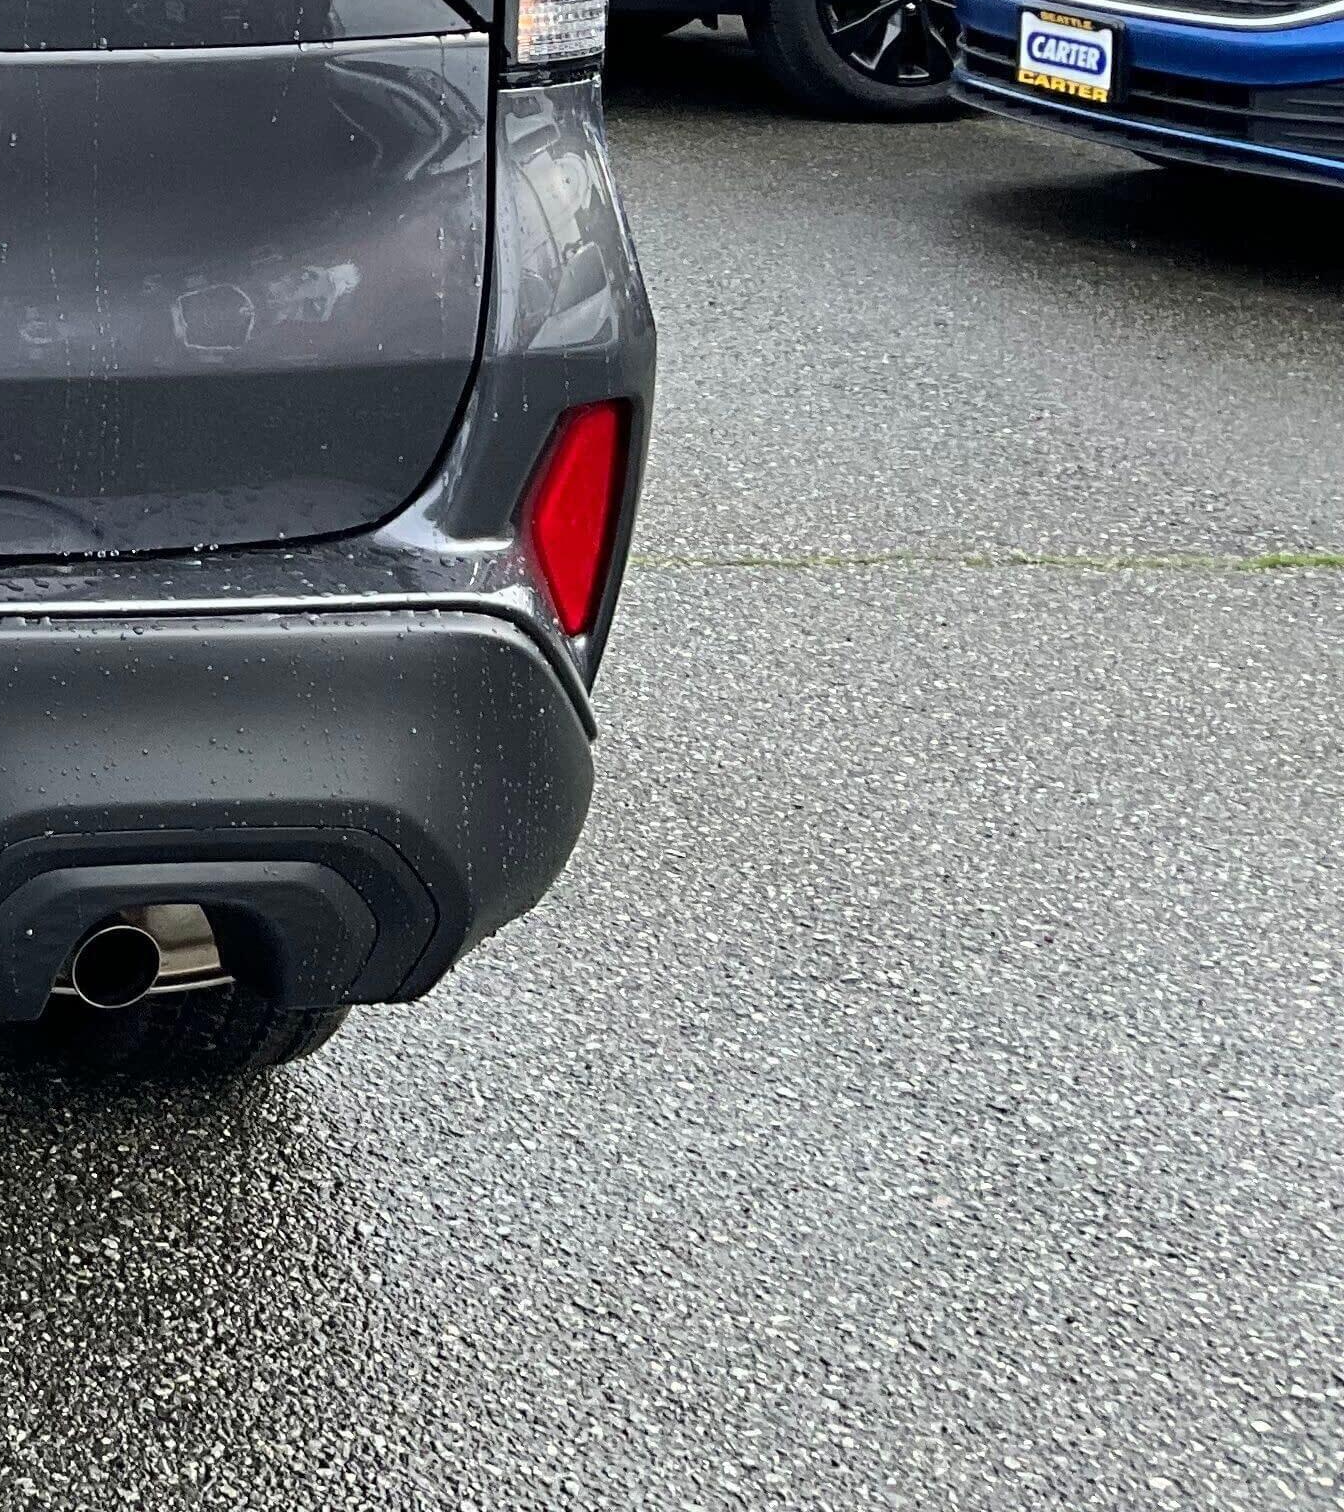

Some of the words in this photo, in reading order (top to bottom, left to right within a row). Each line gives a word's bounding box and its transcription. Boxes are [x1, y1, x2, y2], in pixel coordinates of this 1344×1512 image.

[1040, 11, 1095, 30] SEATTLE
[1032, 35, 1100, 71] CARTER
[1018, 70, 1109, 103] CARTER
